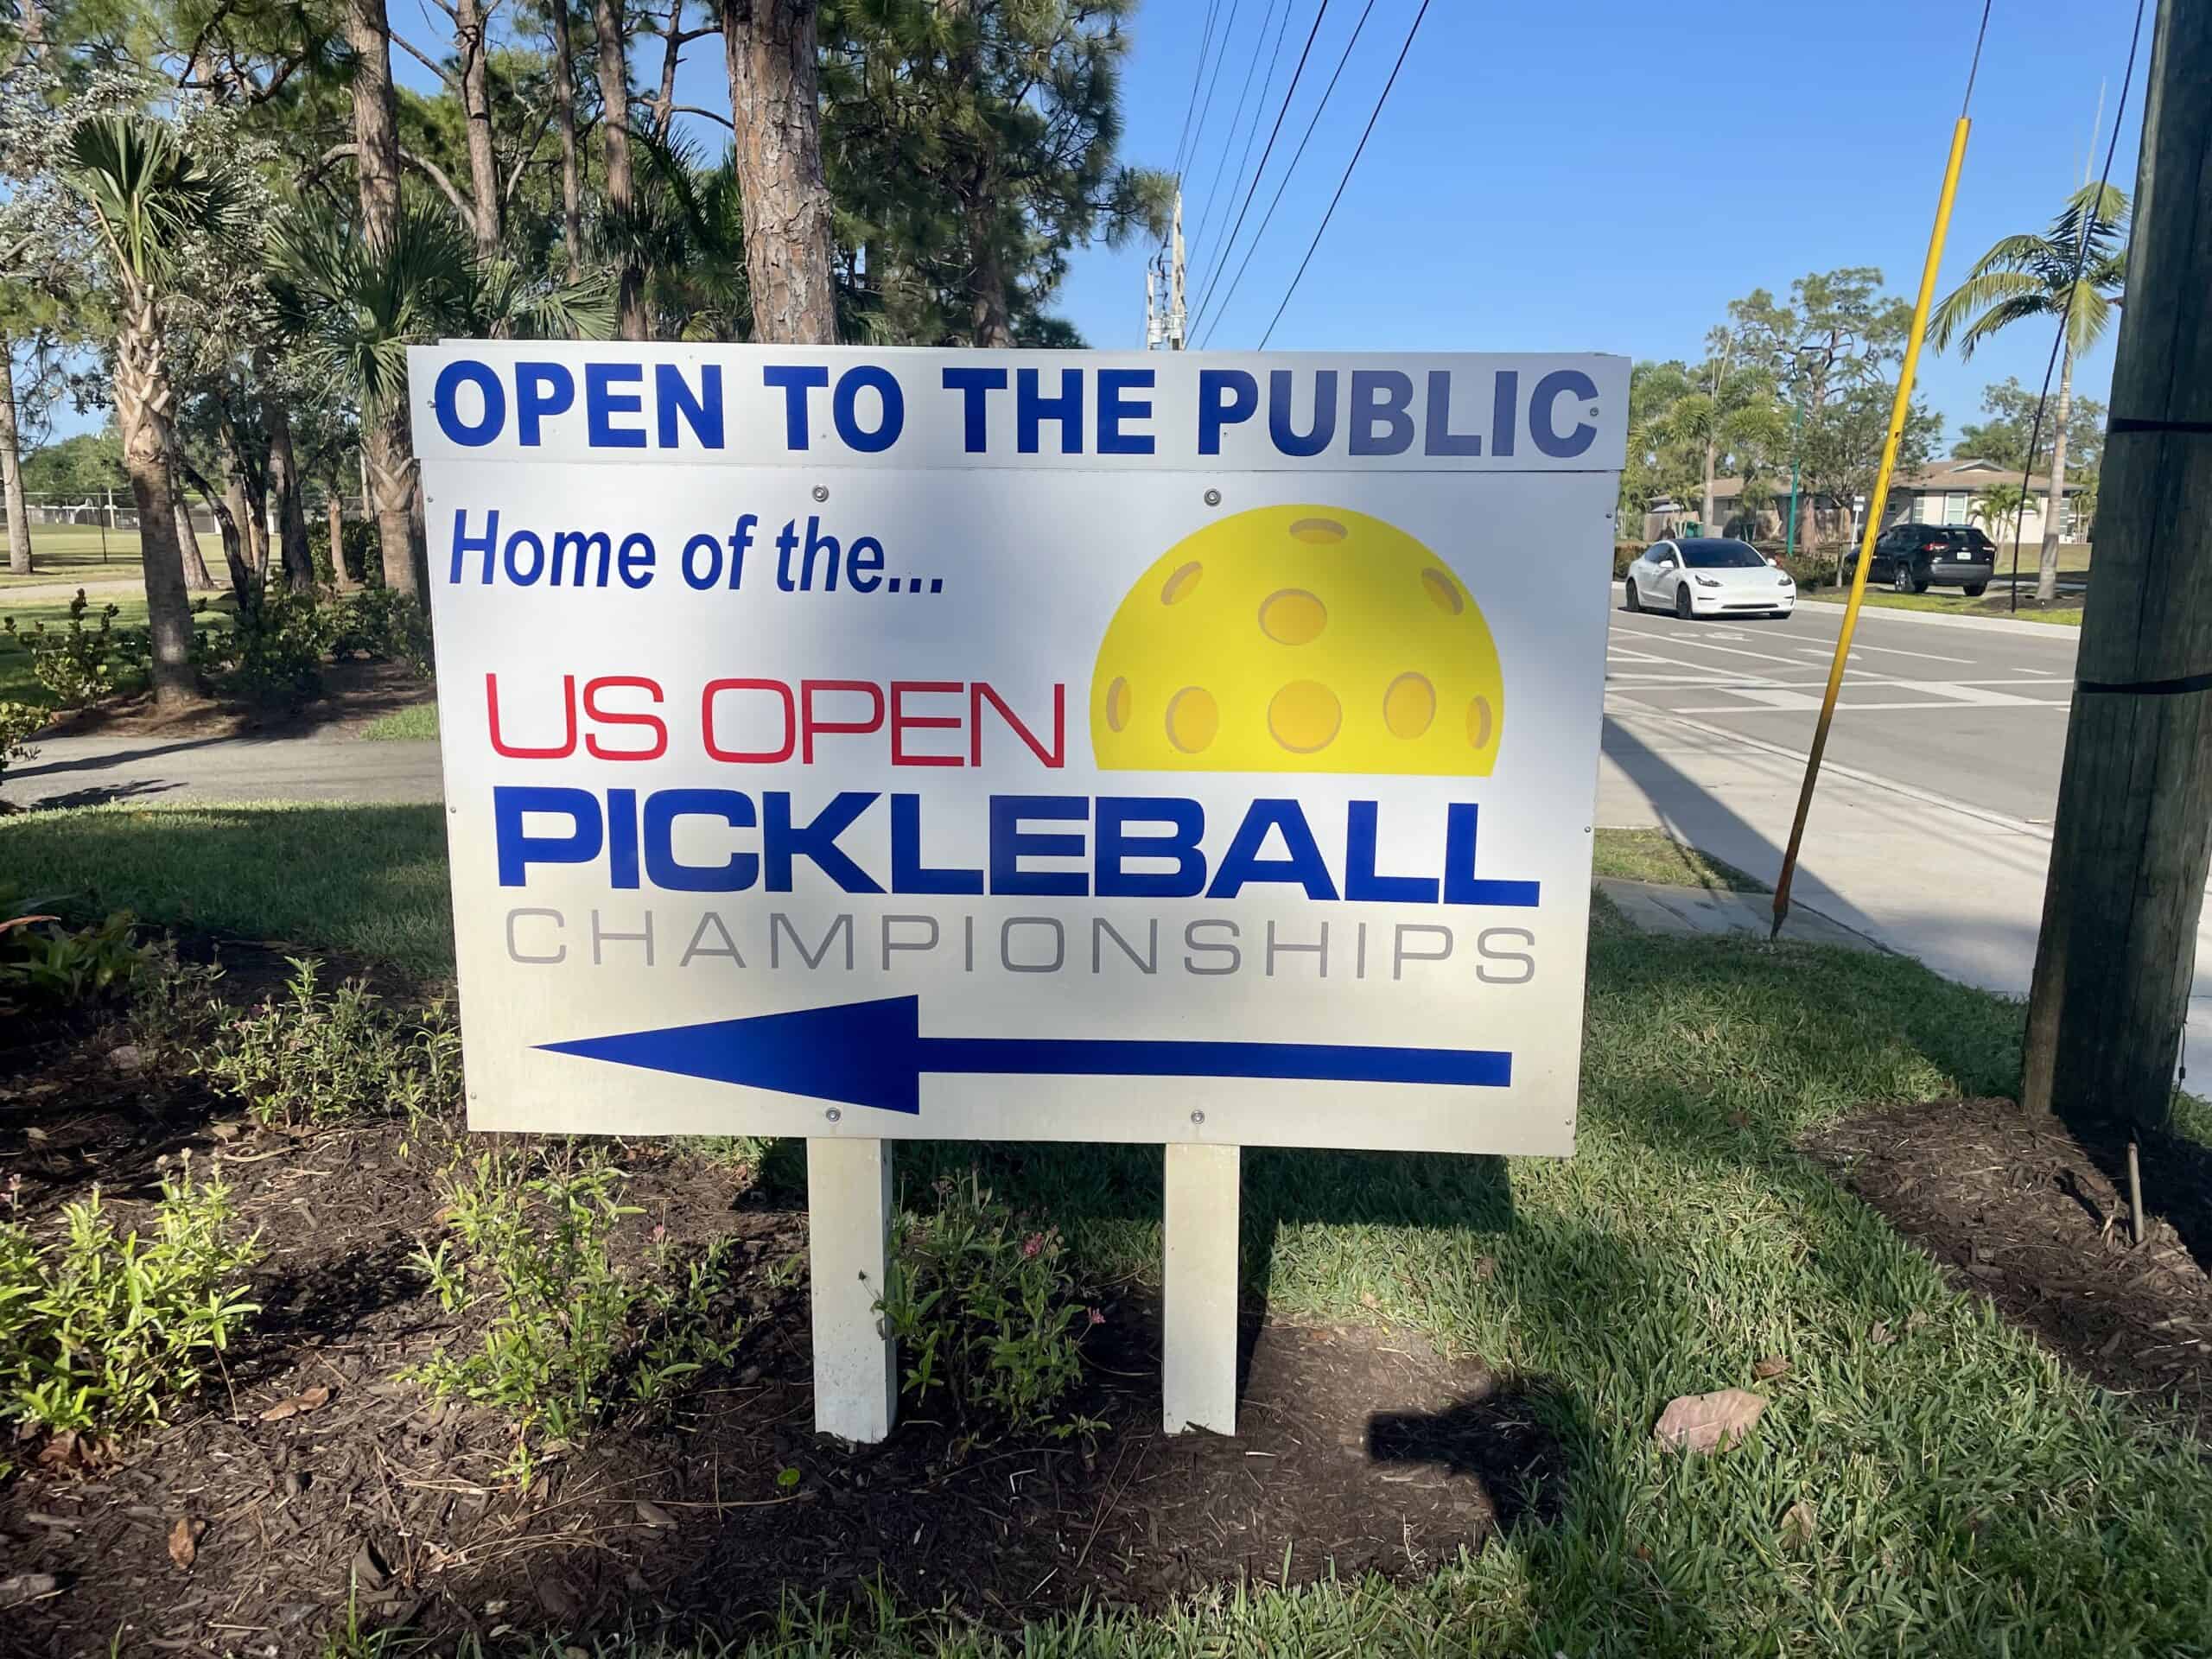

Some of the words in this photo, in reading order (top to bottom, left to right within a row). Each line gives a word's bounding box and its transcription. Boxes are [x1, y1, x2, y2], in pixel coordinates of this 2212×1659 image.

[435, 360, 725, 448] OPEN
[763, 365, 905, 453] TO
[942, 367, 1155, 454] THE
[1198, 369, 1599, 458] PUBLIC
[449, 509, 657, 589] Home
[682, 514, 757, 590] of
[775, 516, 944, 594] the...
[486, 673, 669, 761] US
[702, 678, 1065, 768] OPEN
[493, 785, 1541, 907] PICKLEBALL
[506, 907, 1535, 984] CHAMPIONSHIPS
